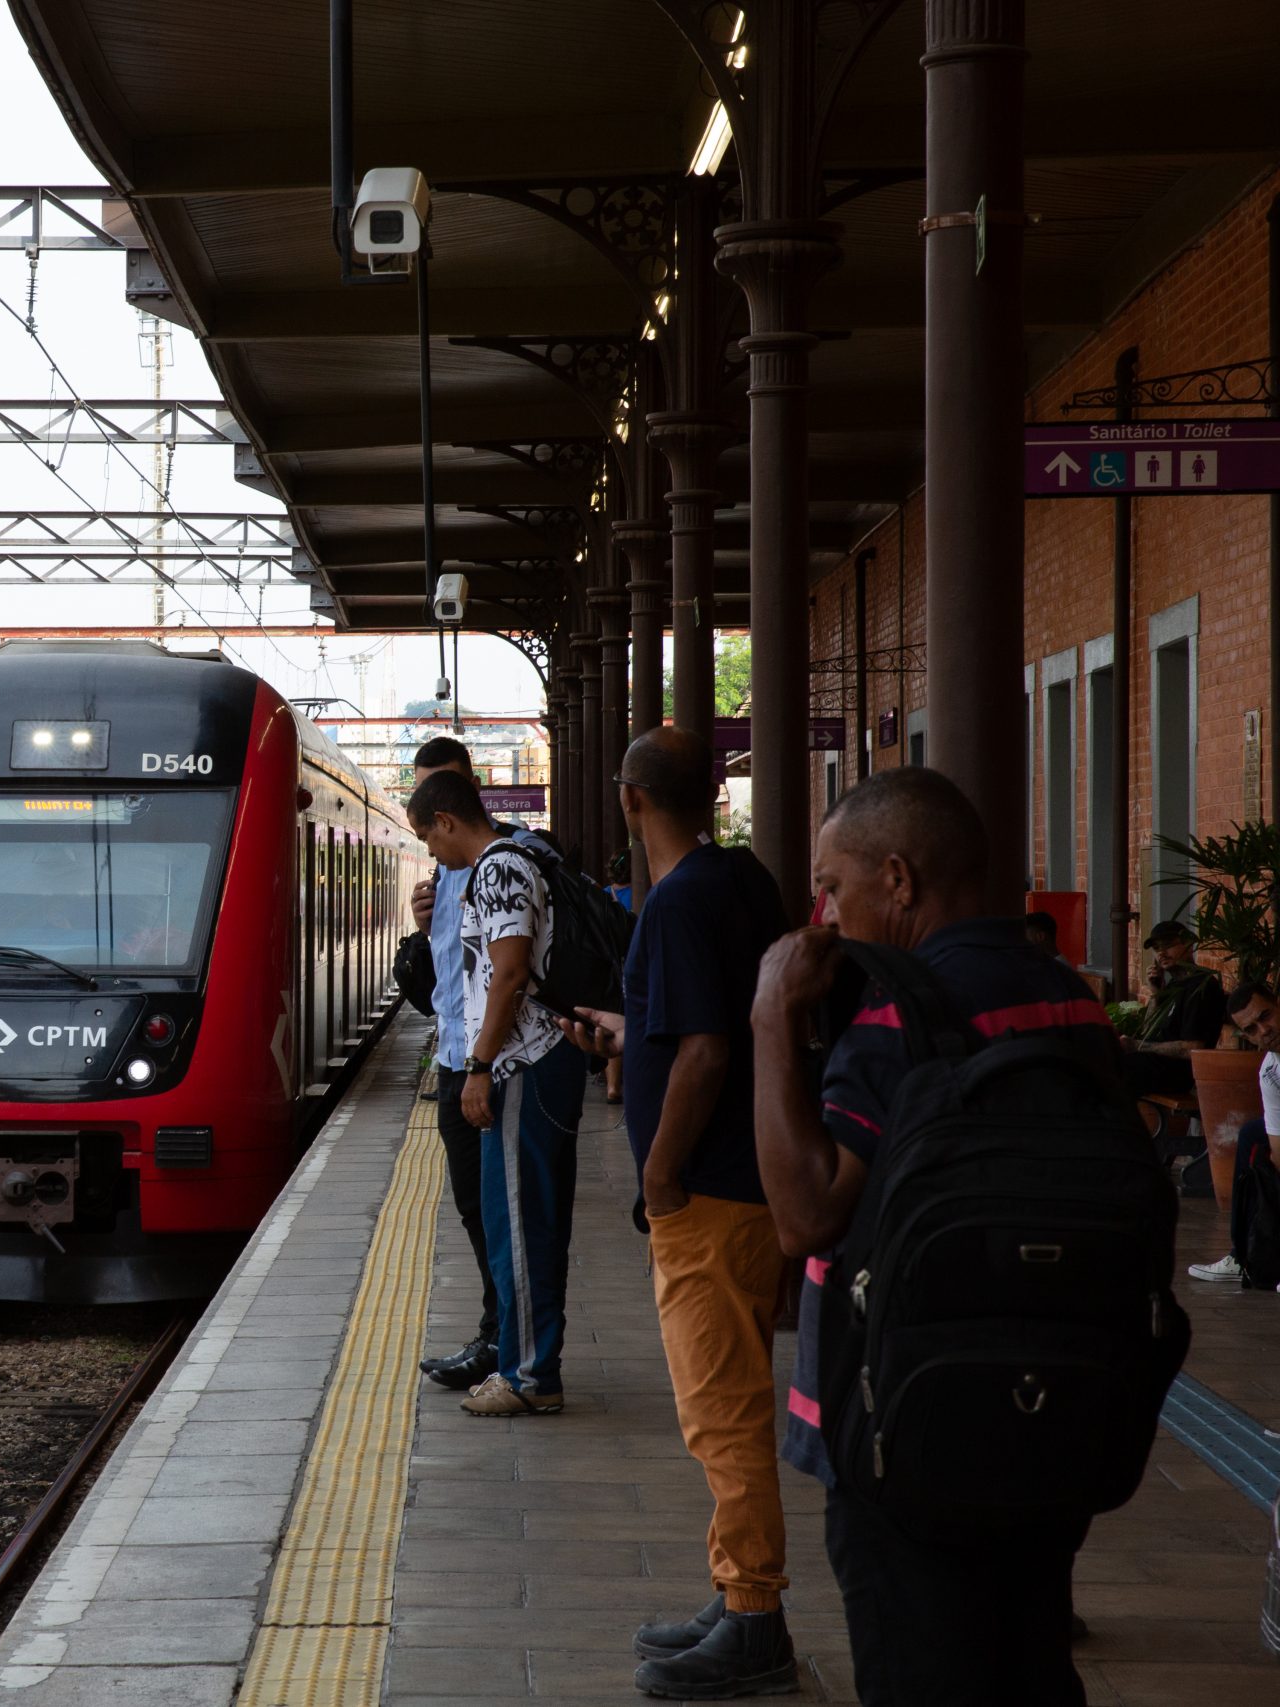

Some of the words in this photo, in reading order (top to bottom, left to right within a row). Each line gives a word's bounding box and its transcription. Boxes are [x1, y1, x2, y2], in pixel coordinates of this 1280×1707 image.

[1089, 425, 1167, 439] Sanitário
[1183, 423, 1232, 437] Toilet
[141, 753, 213, 774] D540
[485, 800, 499, 809] da
[502, 800, 531, 809] Serra
[27, 1025, 107, 1048] CPTM
